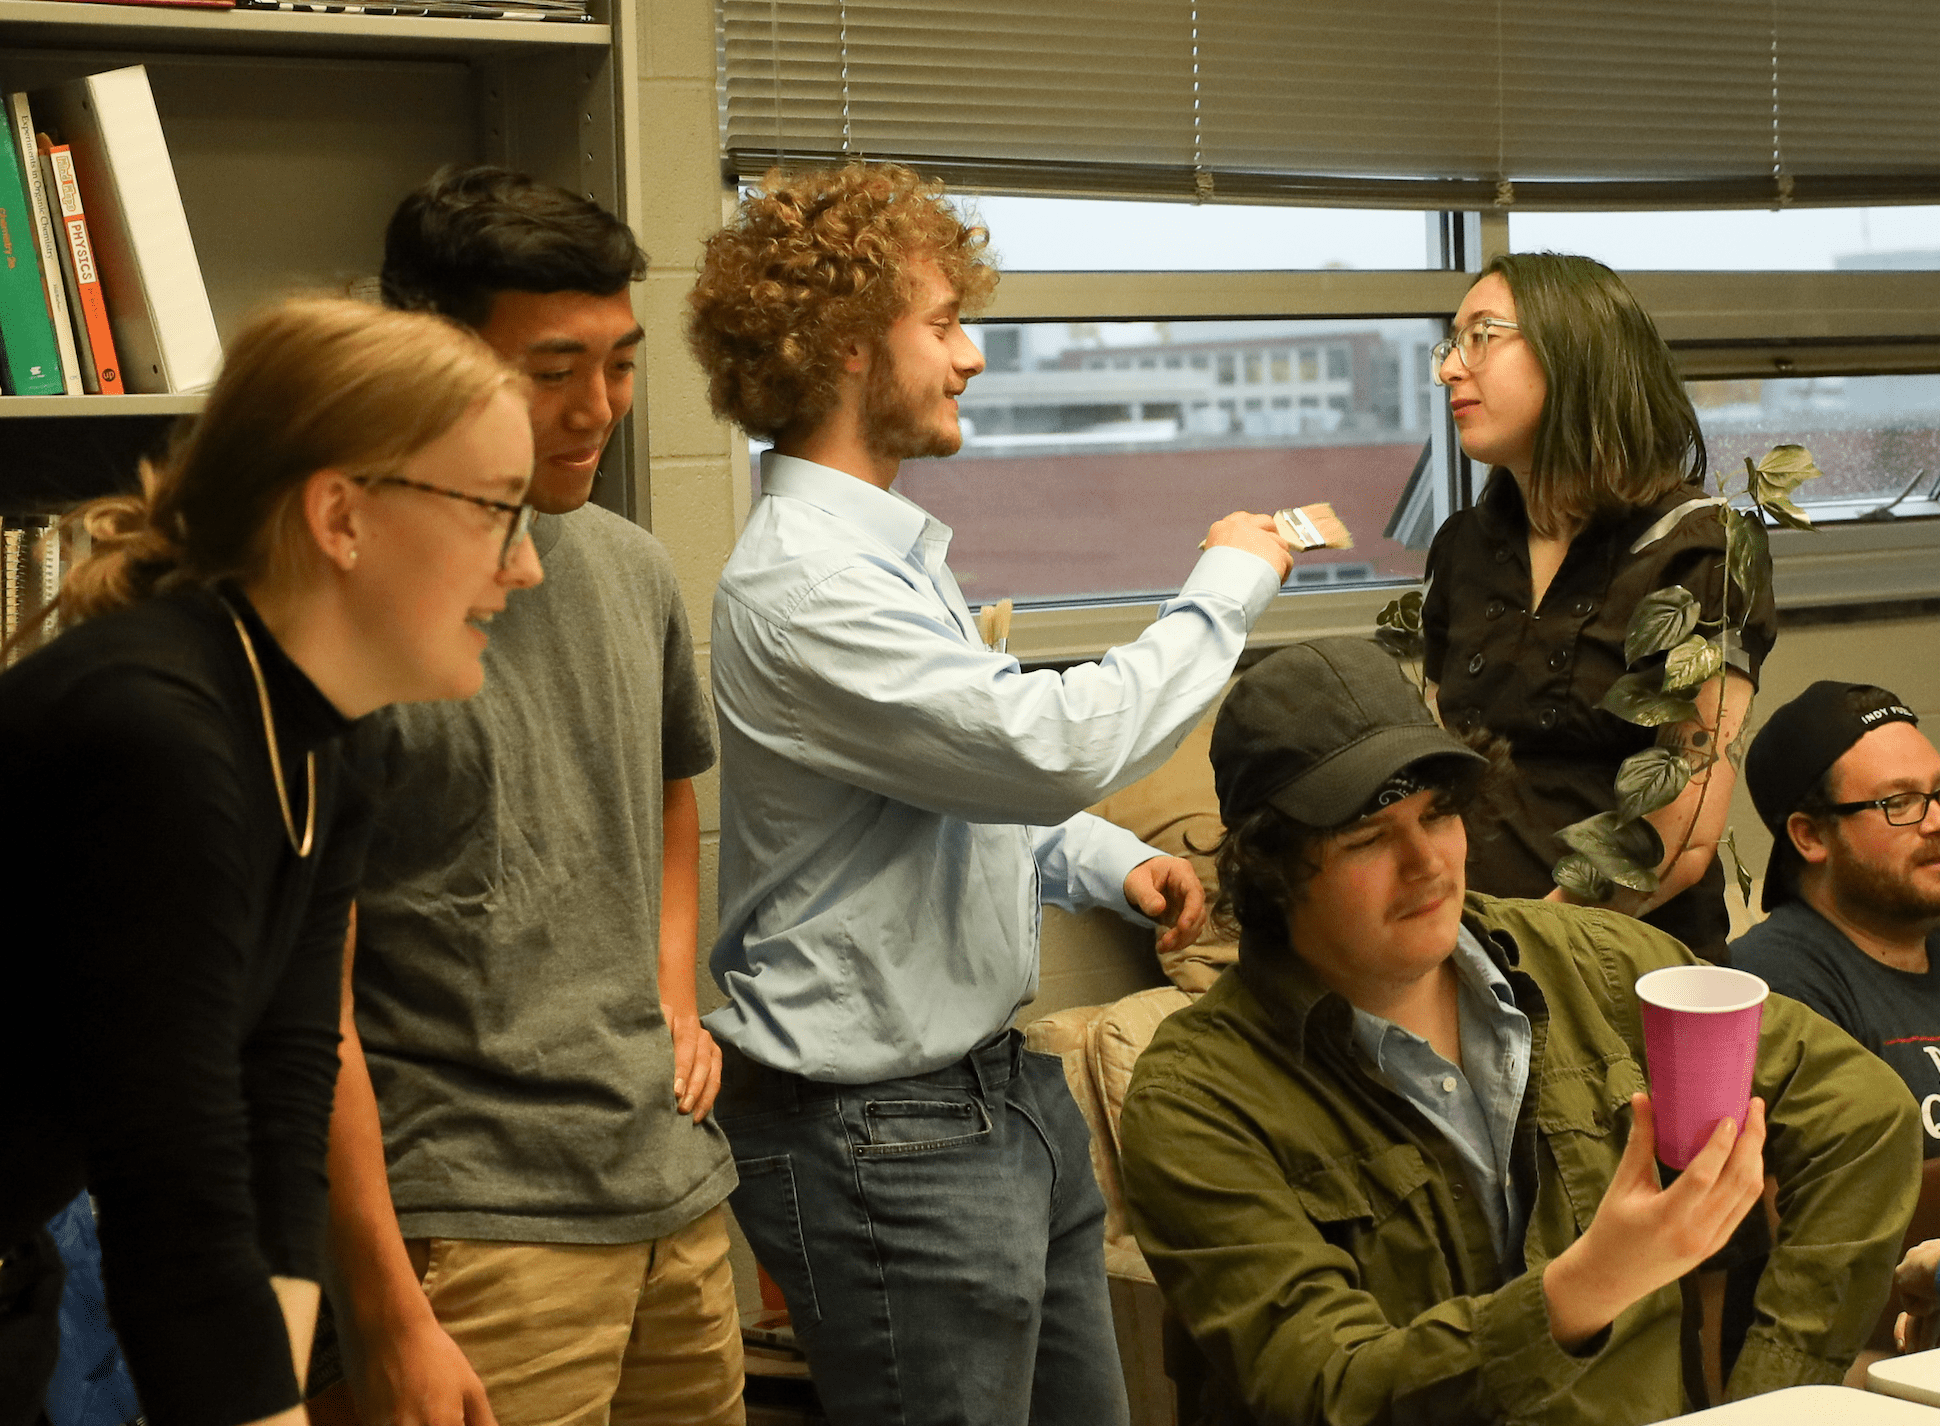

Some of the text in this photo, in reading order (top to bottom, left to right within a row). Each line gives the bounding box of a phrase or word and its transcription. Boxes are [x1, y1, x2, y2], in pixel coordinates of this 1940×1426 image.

[21, 115, 36, 169] Experiments
[34, 180, 45, 214] Organic
[40, 216, 53, 259] Chemistry
[72, 224, 92, 280] PHYSICS
[1861, 707, 1889, 725] INDY
